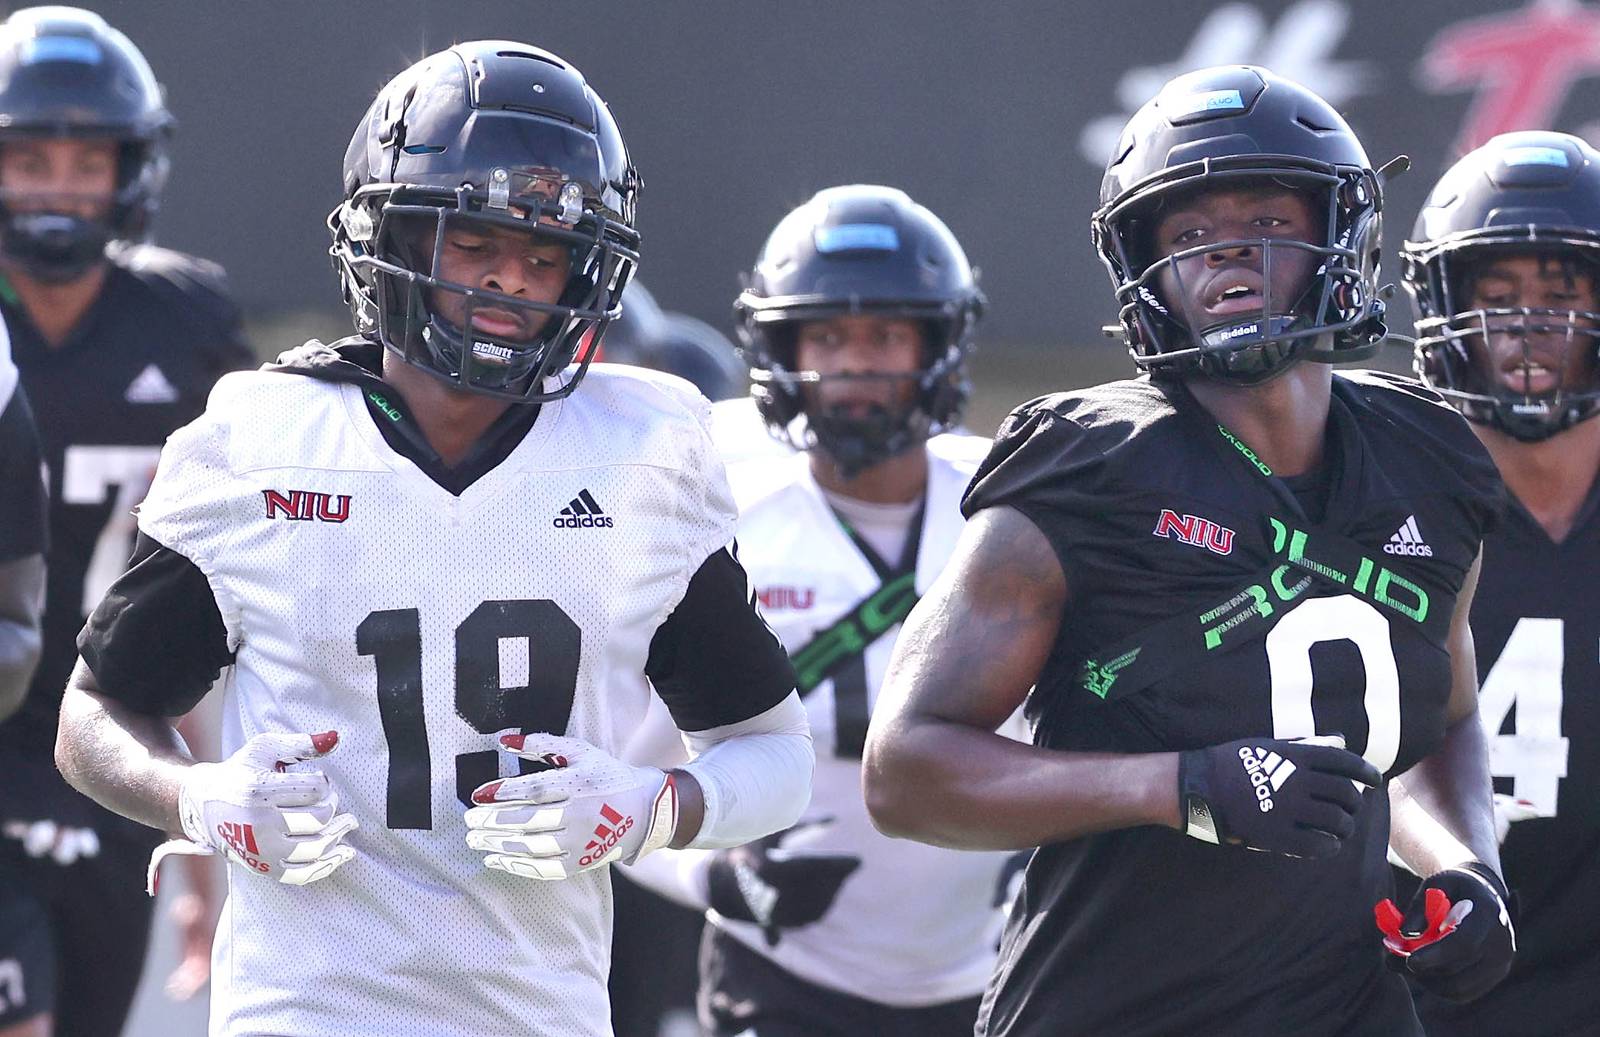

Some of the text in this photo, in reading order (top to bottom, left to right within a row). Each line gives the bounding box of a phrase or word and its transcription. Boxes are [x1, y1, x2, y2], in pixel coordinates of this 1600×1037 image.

[261, 489, 352, 523] NIU
[553, 513, 613, 528] adidas
[1152, 509, 1236, 556] NIU
[1383, 540, 1433, 557] adidas
[1265, 594, 1400, 784] 0
[356, 599, 582, 829] 19
[1238, 746, 1275, 812] adidas
[217, 824, 270, 872] adidas
[578, 815, 634, 866] adidas
